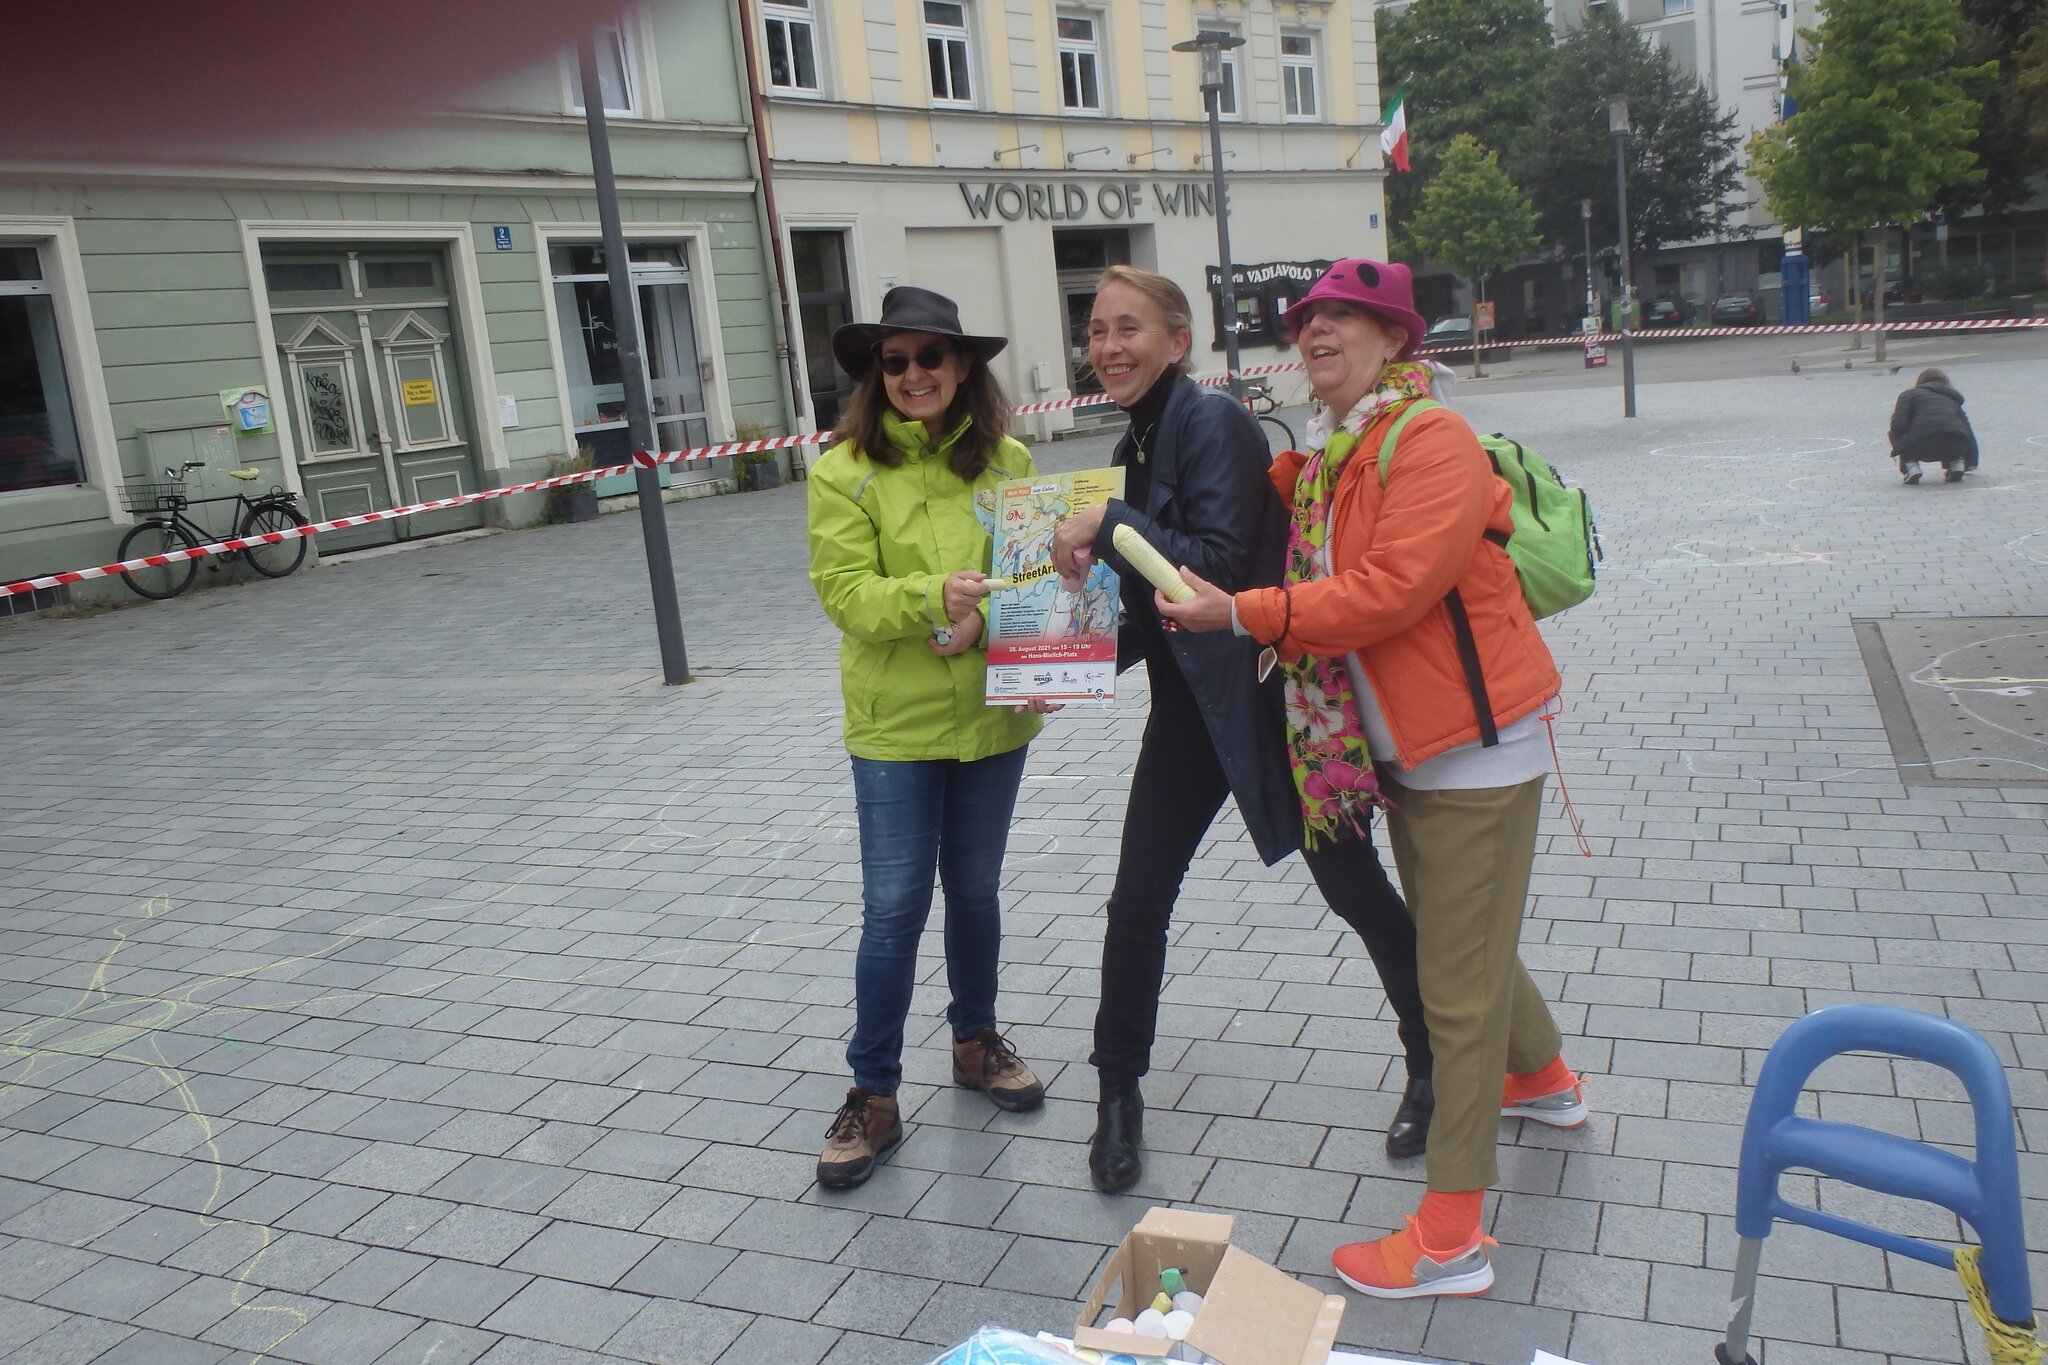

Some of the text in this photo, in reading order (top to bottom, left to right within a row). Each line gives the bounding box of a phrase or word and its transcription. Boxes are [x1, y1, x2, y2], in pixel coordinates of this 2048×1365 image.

[959, 182, 1088, 221] WORLD
[1098, 183, 1142, 219] OF
[499, 228, 505, 238] 2
[1212, 273, 1244, 285] Faria
[1247, 264, 1312, 283] VADIAVOLO
[1028, 651, 1077, 659] Hans-Mielich-Platz
